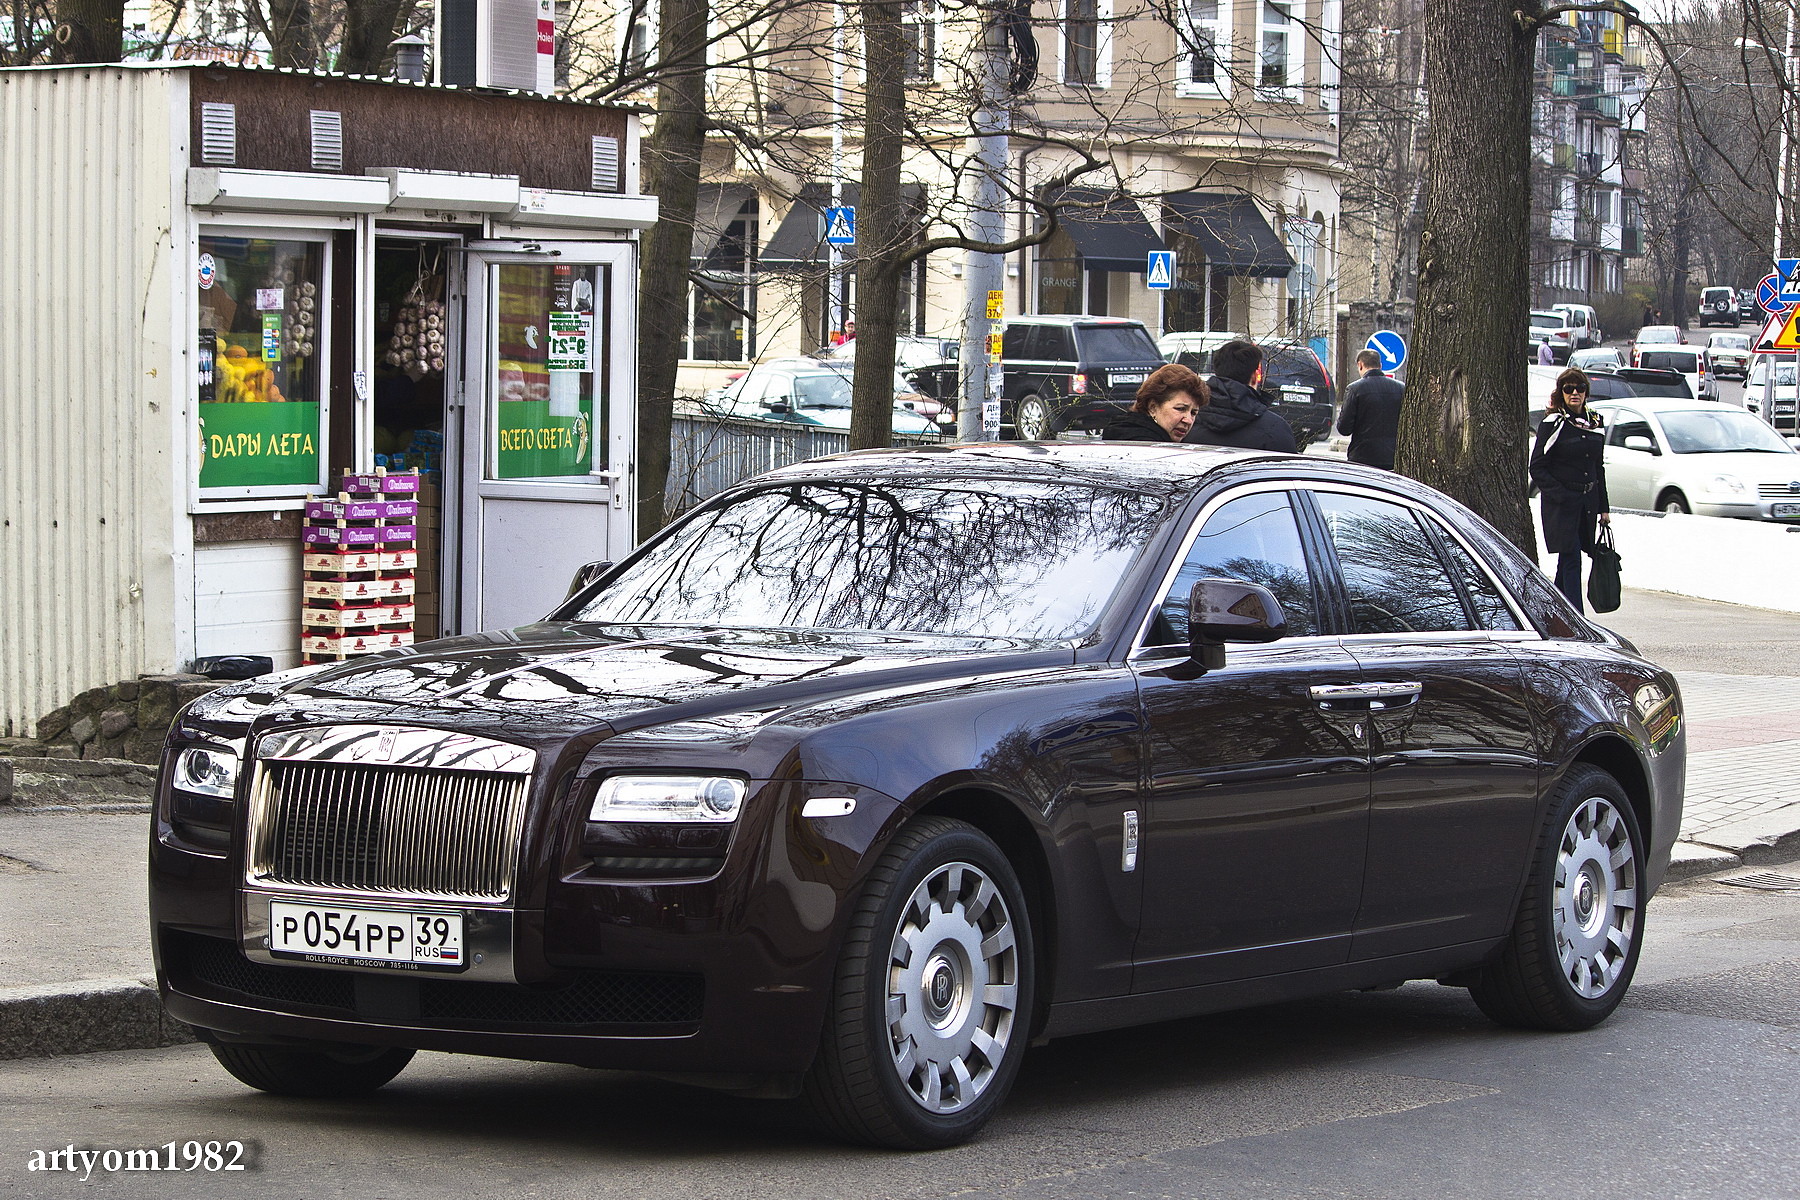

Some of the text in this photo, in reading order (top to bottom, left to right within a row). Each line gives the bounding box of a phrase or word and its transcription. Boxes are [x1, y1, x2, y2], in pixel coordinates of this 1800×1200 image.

[537, 31, 553, 43] Haier
[1041, 277, 1077, 288] GRANGE
[1174, 280, 1200, 290] RANGE
[986, 404, 1000, 413] ДЕН
[501, 427, 573, 451] ВСЕГО СВЕТА
[210, 432, 315, 459] ДАРЫ ЛЕТА
[283, 910, 450, 954] P054PP 39
[415, 946, 440, 958] RUS
[353, 959, 386, 968] MOSCOW
